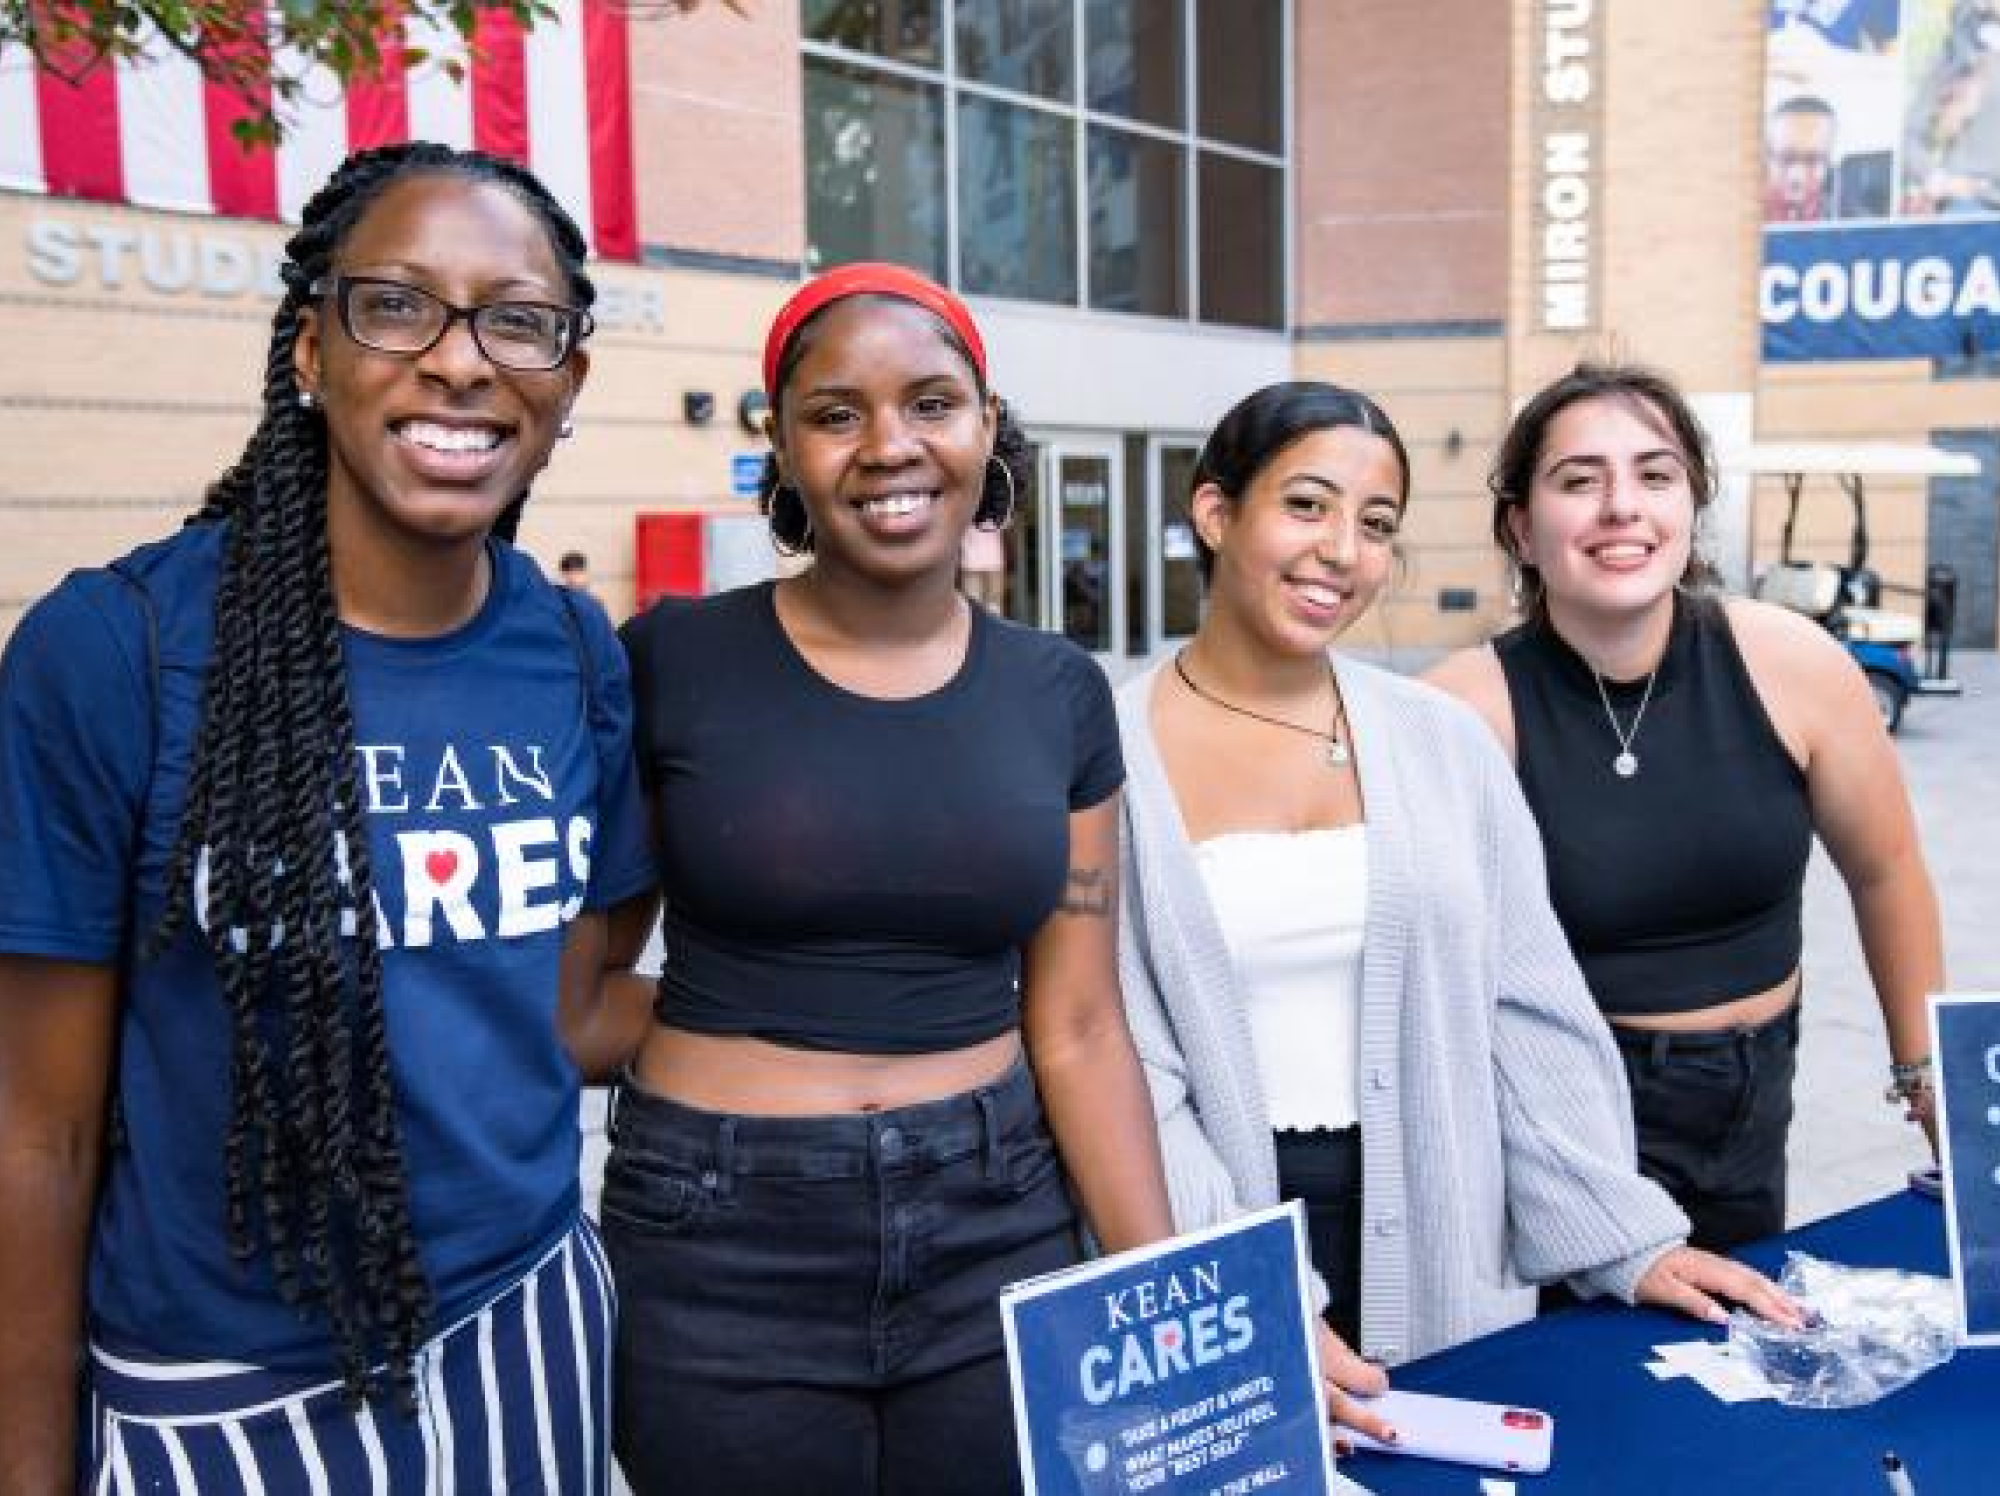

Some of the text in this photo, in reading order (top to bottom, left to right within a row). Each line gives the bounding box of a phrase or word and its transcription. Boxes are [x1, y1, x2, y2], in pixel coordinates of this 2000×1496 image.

[1546, 132, 1589, 327] MIRON
[1759, 256, 2000, 323] COUGA
[352, 743, 554, 814] EAN
[1105, 1260, 1222, 1331] KEAN
[1079, 1295, 1254, 1406] CARES
